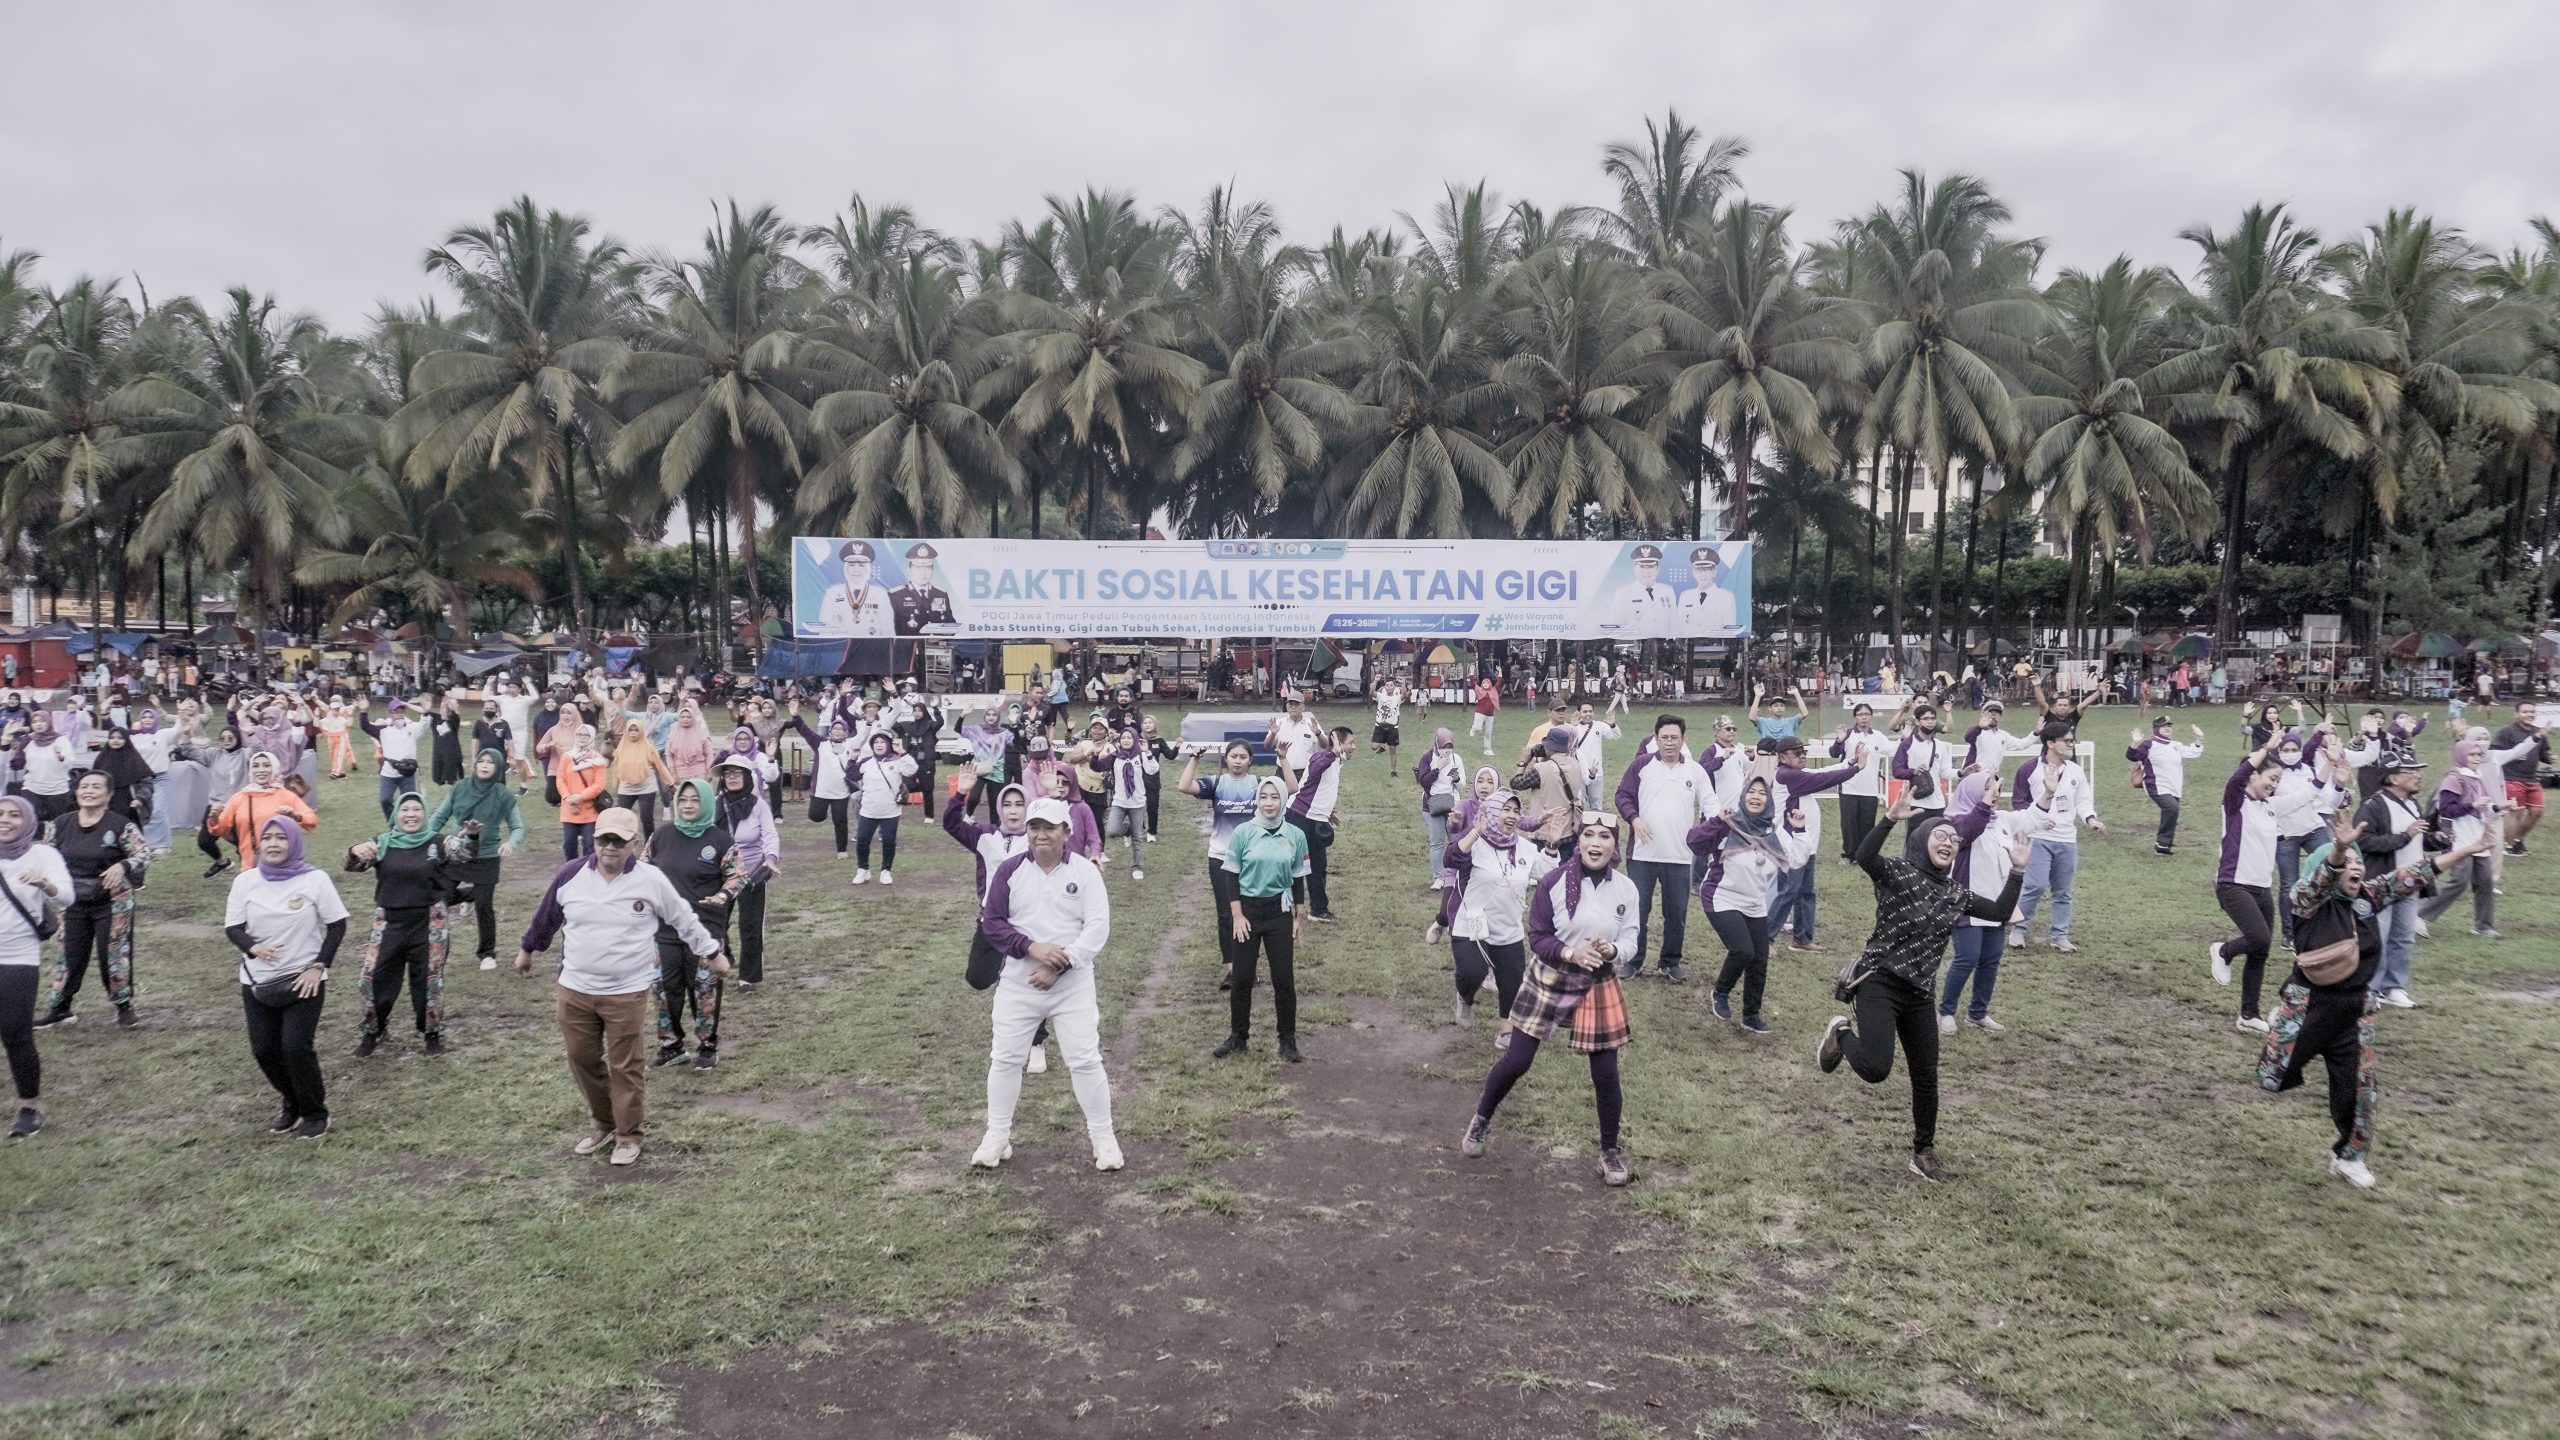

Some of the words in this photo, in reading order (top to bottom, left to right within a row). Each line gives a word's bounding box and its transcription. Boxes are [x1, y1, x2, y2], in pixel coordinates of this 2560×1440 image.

[968, 568, 1085, 600] BAKTI
[1096, 568, 1238, 601] SOSIAL
[1248, 568, 1484, 601] KESEHATAN
[1495, 568, 1578, 601] GIGI
[982, 611, 1010, 620] PDGI
[1013, 611, 1042, 620] Jawa
[1046, 611, 1078, 620] Timur
[1082, 611, 1118, 620] Peduli
[1122, 611, 1197, 622] Pengentasan
[1200, 611, 1250, 622] Stunting
[1254, 611, 1310, 621] Indonesia
[1526, 613, 1564, 623] Wayahe
[1342, 618, 1368, 627] 25-26
[968, 623, 1005, 632] Bebas
[1008, 623, 1065, 633] Stunting,
[1069, 623, 1093, 633] Gigi
[1096, 623, 1118, 632] dan
[1122, 623, 1160, 632] Tubuh
[1163, 623, 1201, 633] Sehat,
[1204, 623, 1264, 632] Indonesia
[1268, 623, 1316, 632] Tumbuh
[1504, 623, 1539, 631] Jember
[1541, 623, 1577, 633] Bangkit
